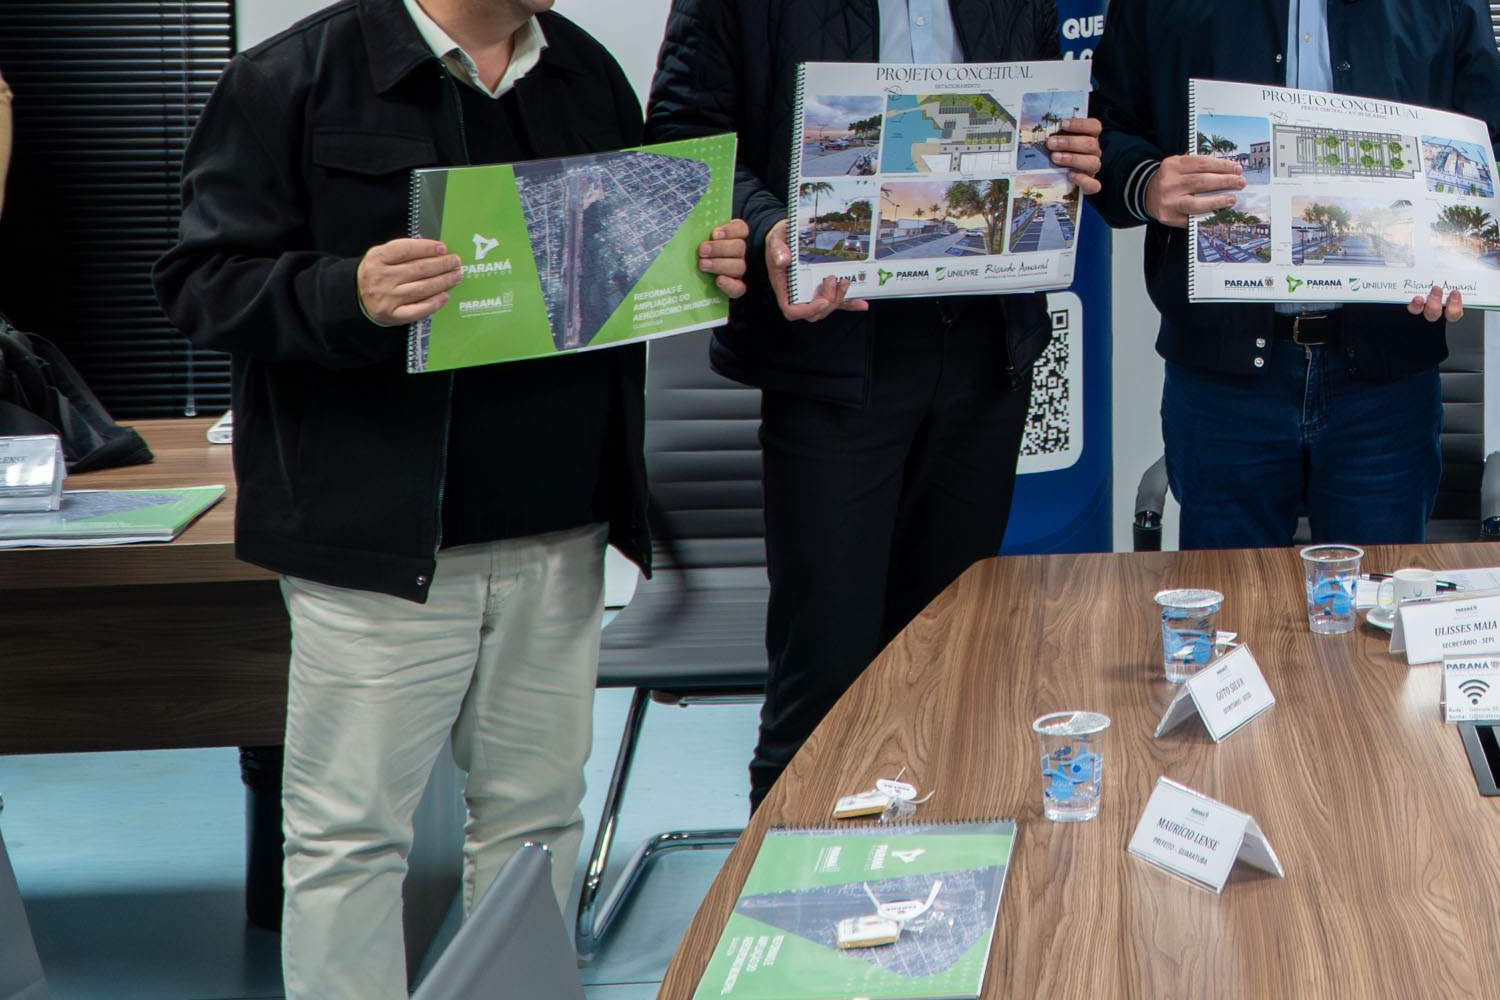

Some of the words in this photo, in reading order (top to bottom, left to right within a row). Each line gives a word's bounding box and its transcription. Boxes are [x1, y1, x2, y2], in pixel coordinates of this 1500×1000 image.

[1062, 14, 1104, 40] QUE
[876, 67, 943, 82] PROJETO
[945, 65, 1033, 81] CONCEITUAL
[1261, 89, 1327, 106] PROJETO
[1330, 98, 1424, 121] CONCEITUAL
[947, 268, 979, 278] UNILIVRE
[1224, 278, 1264, 287] PARANÁ
[1306, 278, 1343, 287] PARANÁ
[1362, 281, 1397, 290] UNILIVRE
[1403, 279, 1434, 289] Ricard
[1434, 623, 1472, 637] ULISSES
[1473, 620, 1498, 632] MAIA
[1442, 639, 1478, 648] SECRETÁRIO
[1446, 662, 1489, 670] PARANÁ
[1157, 816, 1195, 841] MAURÍCIO
[1193, 832, 1220, 851] LENSE
